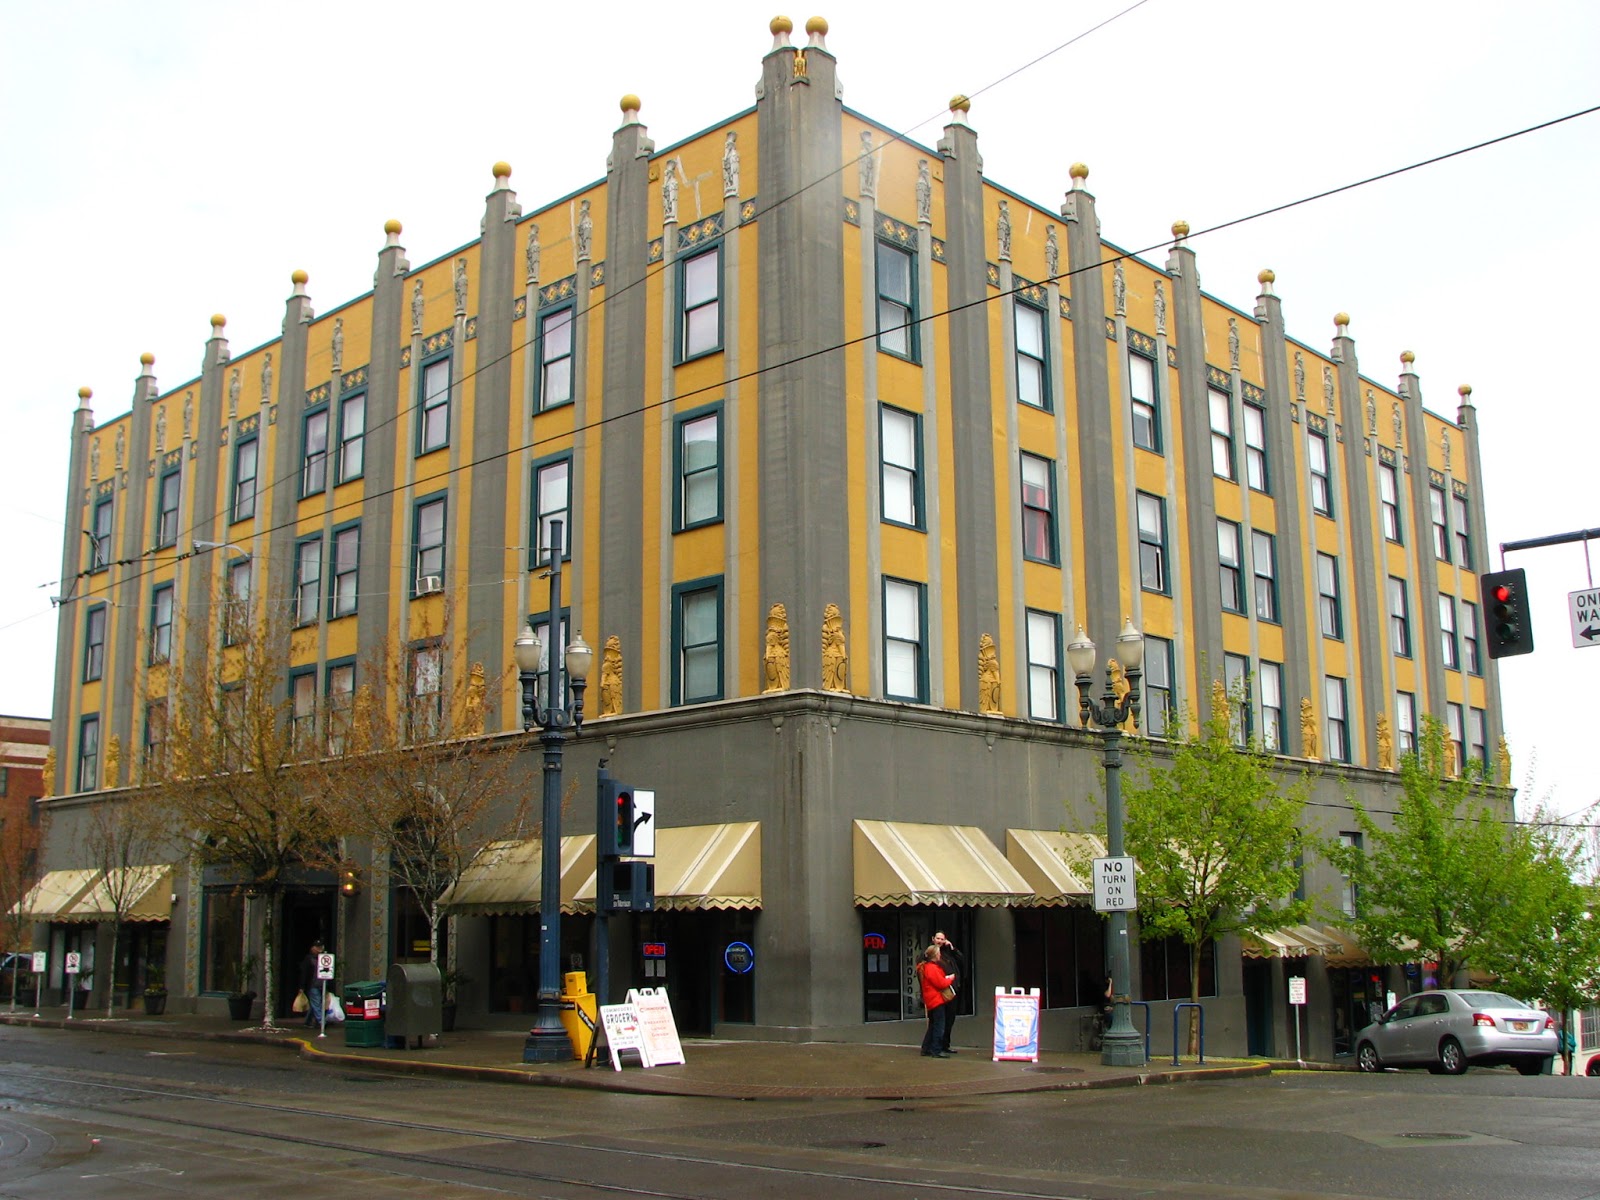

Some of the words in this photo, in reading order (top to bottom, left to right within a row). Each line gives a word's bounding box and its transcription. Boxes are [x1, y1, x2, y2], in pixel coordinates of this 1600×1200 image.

[1576, 593, 1600, 607] ON
[1577, 608, 1600, 622] WA
[1104, 862, 1123, 873] NO
[1102, 875, 1126, 884] TURN
[1107, 886, 1121, 895] ON
[1106, 897, 1124, 907] RED
[644, 945, 664, 955] OPEN
[906, 926, 914, 1015] COMMODORE
